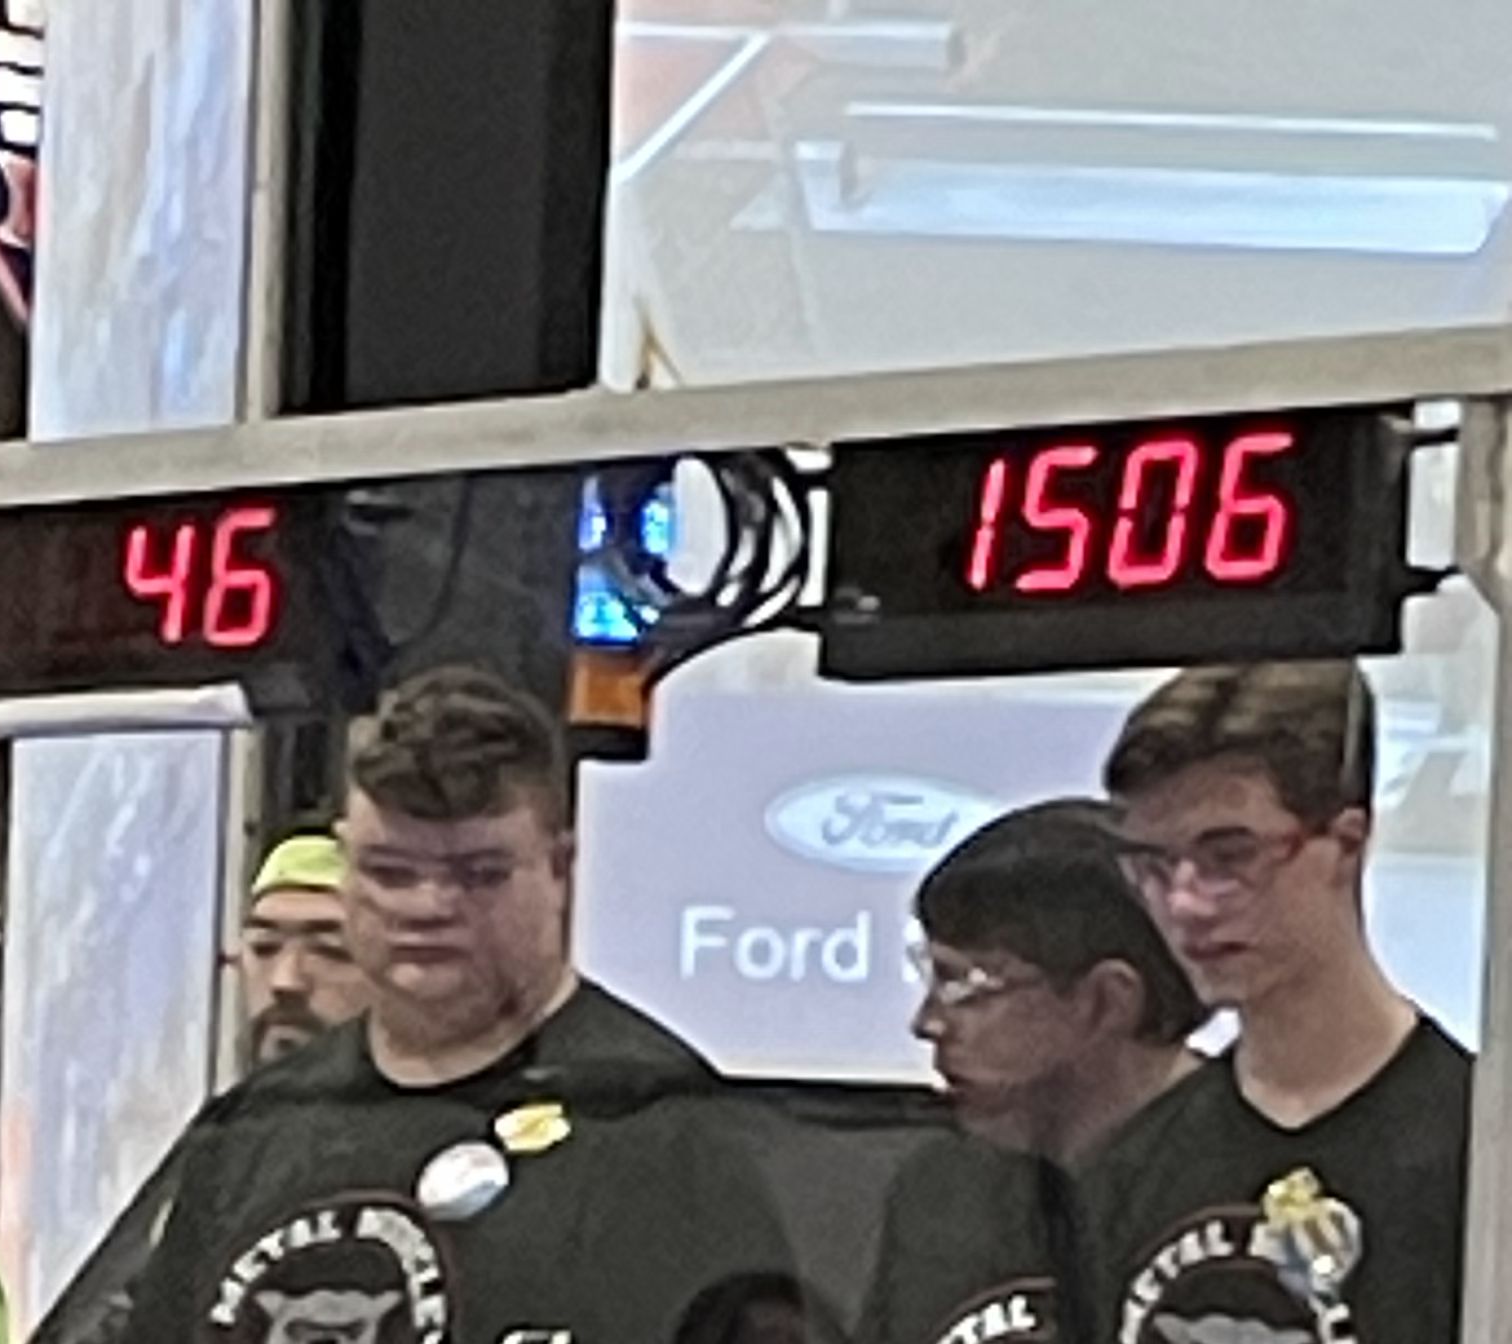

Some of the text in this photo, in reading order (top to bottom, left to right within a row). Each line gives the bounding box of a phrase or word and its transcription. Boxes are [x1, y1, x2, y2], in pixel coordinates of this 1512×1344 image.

[969, 432, 1293, 591] 1506
[126, 507, 275, 646] 46
[821, 790, 960, 847] Ford
[679, 904, 873, 984] Ford
[209, 1208, 342, 1326] METAL
